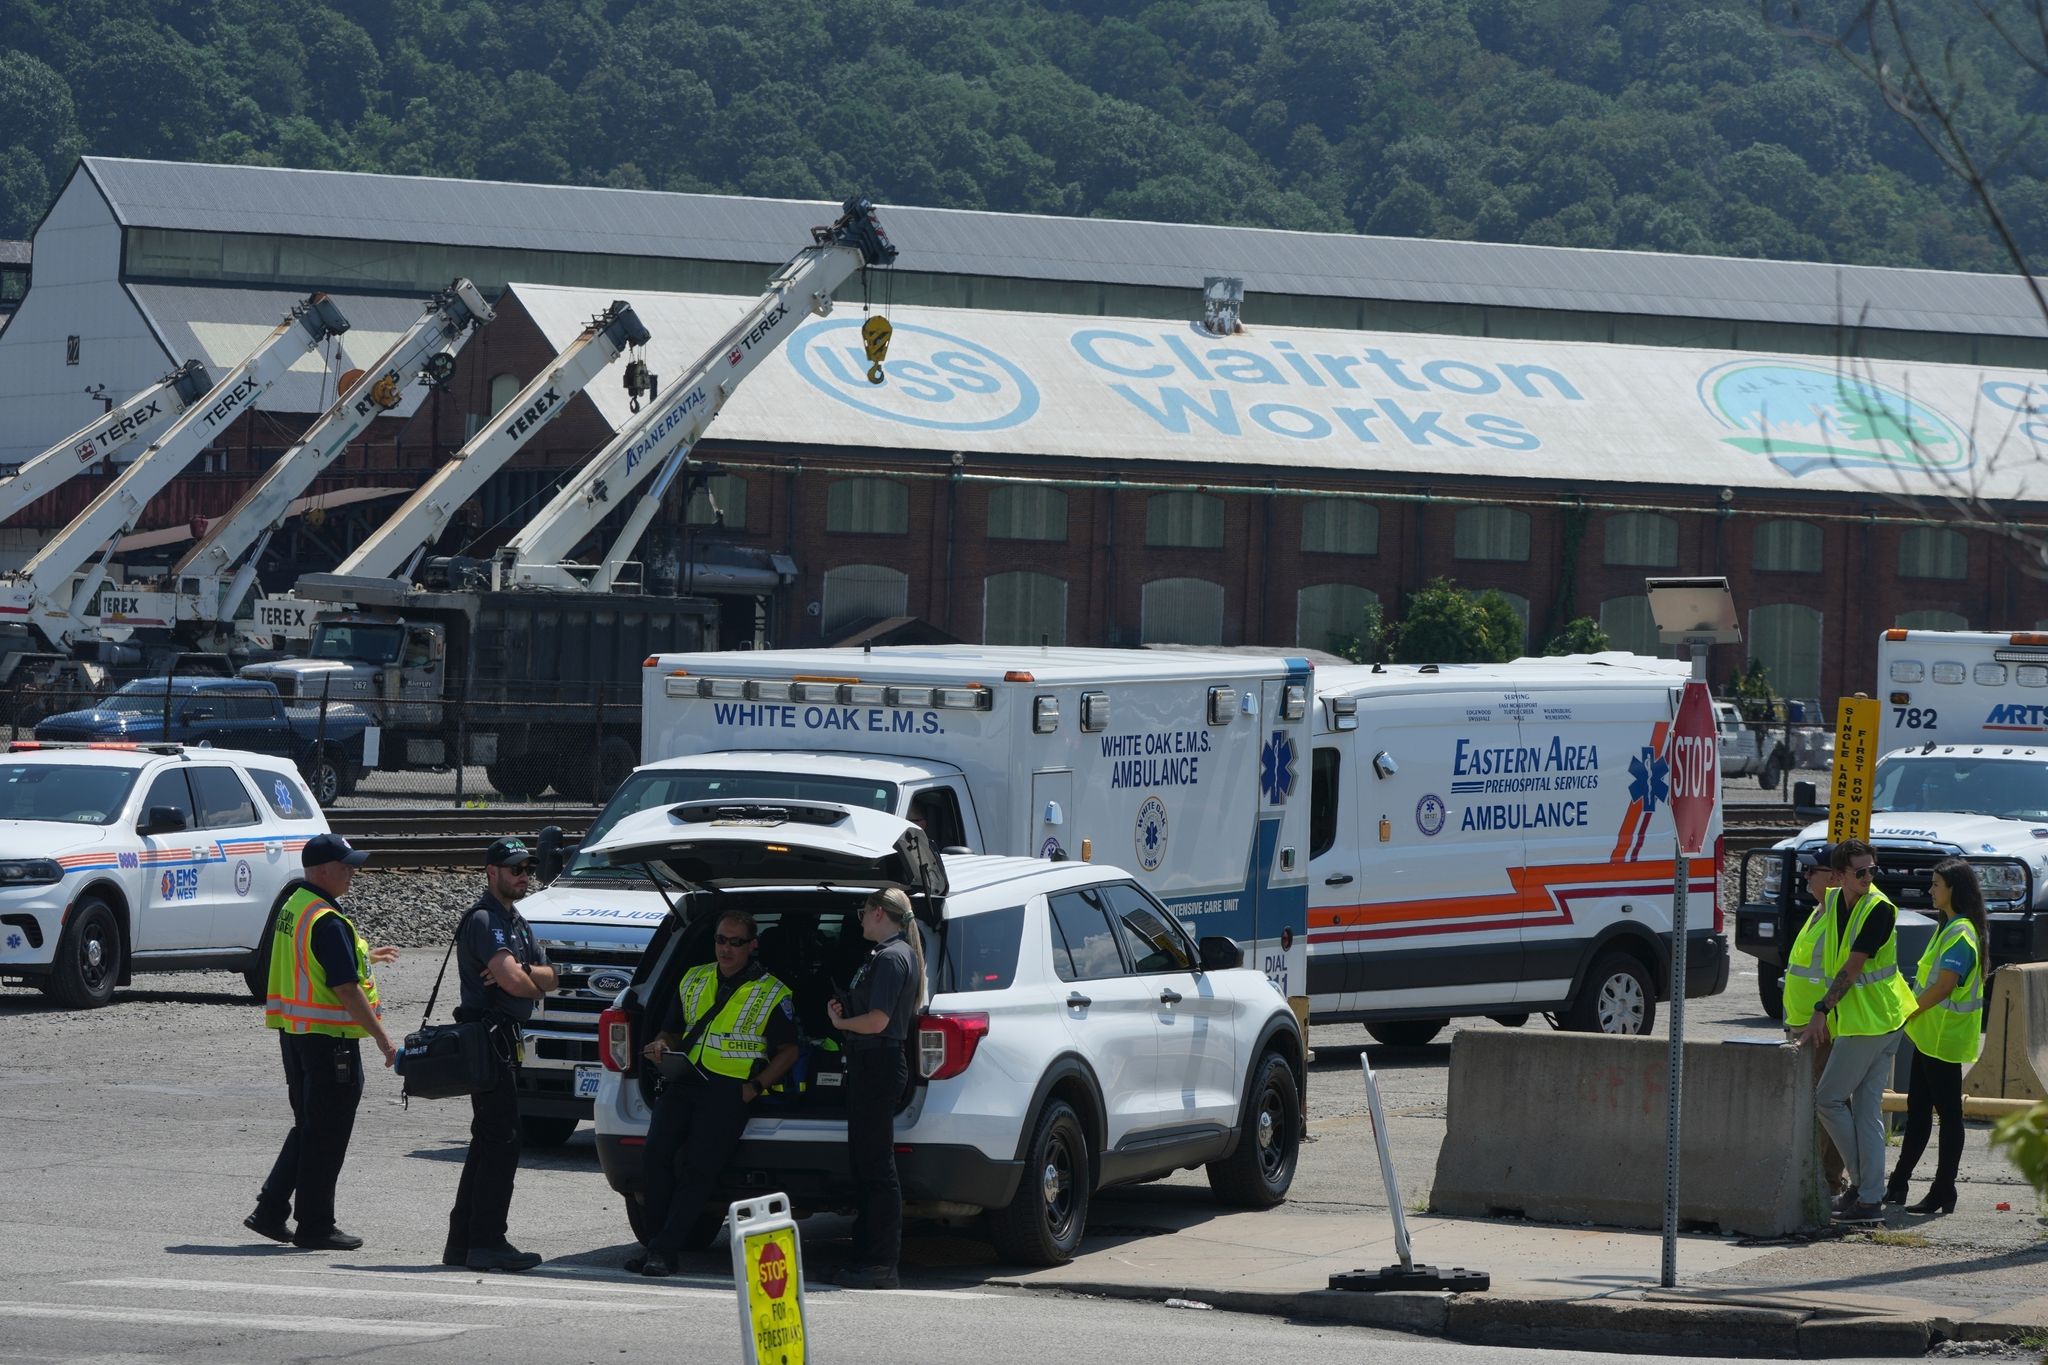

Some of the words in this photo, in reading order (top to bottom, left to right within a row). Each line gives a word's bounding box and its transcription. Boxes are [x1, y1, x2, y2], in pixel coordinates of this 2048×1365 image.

[741, 303, 789, 350] TEREX
[813, 345, 1001, 403] USS
[1071, 329, 1585, 400] Clairton
[203, 376, 259, 427] TEREX
[506, 387, 561, 441] TEREX
[666, 387, 706, 432] RENTAL
[1107, 383, 1542, 451] Works
[96, 400, 162, 447] TEREX
[103, 597, 139, 614] TEREX
[260, 607, 305, 626] TEREX
[714, 703, 796, 728] WHITE
[804, 706, 860, 731] OAK
[868, 709, 945, 735] E.M.S.
[1840, 707, 1853, 758] SINGLE
[1893, 708, 1937, 729] 782
[1101, 735, 1142, 757] WHITE
[1145, 732, 1172, 755] OAK
[1175, 730, 1211, 753] E.M.S.
[1855, 730, 1866, 772] FIRST
[1111, 757, 1198, 788] AMBULANCE
[1673, 736, 1713, 798] STOP
[1837, 764, 1848, 797] LANE
[1485, 777, 1551, 793] PREHOSPITAL
[1554, 775, 1598, 790] SERVICES
[1851, 778, 1862, 803] ROW
[1461, 801, 1588, 831] AMBULANCE
[1833, 803, 1845, 844] PARKI
[176, 869, 198, 887] EMS
[176, 888, 198, 900] WEST
[1203, 900, 1222, 914] CARE
[1223, 898, 1239, 912] UNIT
[1265, 954, 1287, 973] DIAL
[599, 977, 620, 989] Ford
[728, 1041, 758, 1050] CHIEF
[760, 1259, 786, 1283] STOP
